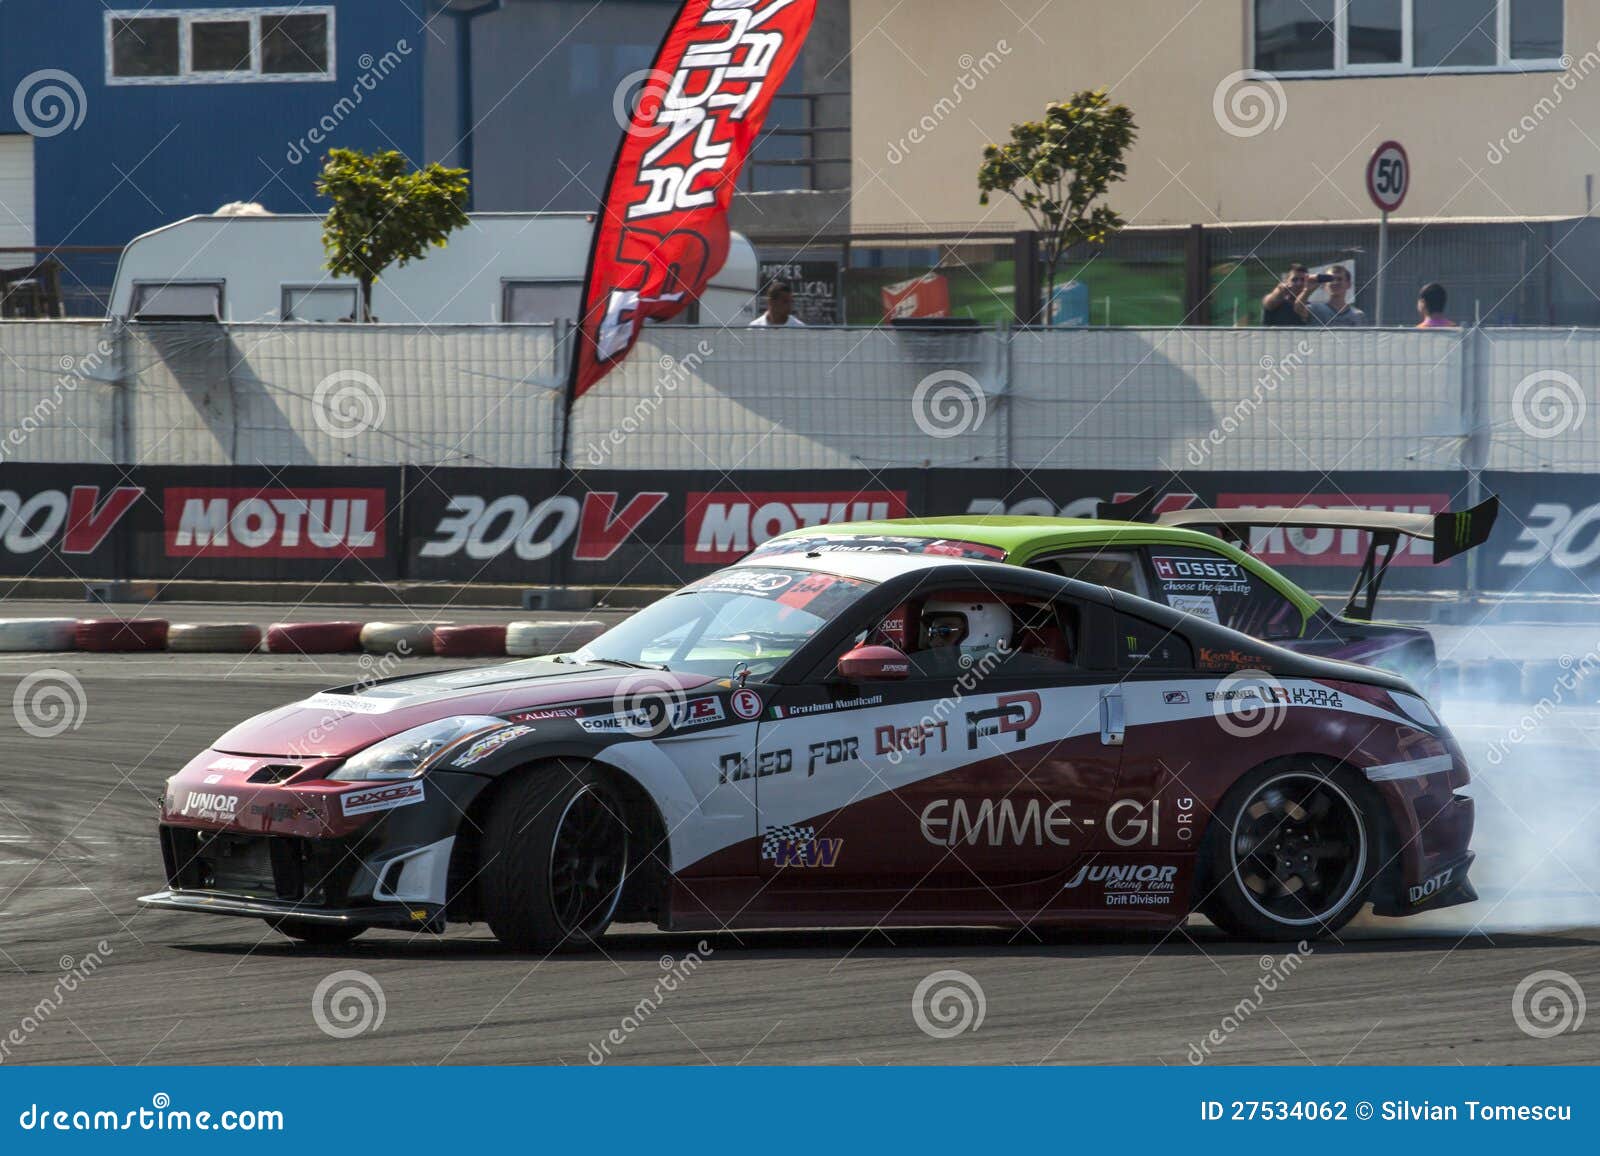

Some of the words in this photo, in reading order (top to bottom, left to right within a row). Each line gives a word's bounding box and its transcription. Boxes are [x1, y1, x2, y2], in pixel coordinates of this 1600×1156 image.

[1377, 158, 1402, 193] 50
[175, 498, 377, 548] MOTUL
[419, 492, 669, 561] 300V
[1292, 687, 1339, 700] ULTRA
[1294, 697, 1343, 708] RACING
[808, 736, 859, 778] FOR
[181, 791, 239, 815] JUNIOR
[1064, 864, 1178, 889] JUNIOR
[1106, 894, 1128, 906] Drift
[1129, 893, 1170, 905] Division
